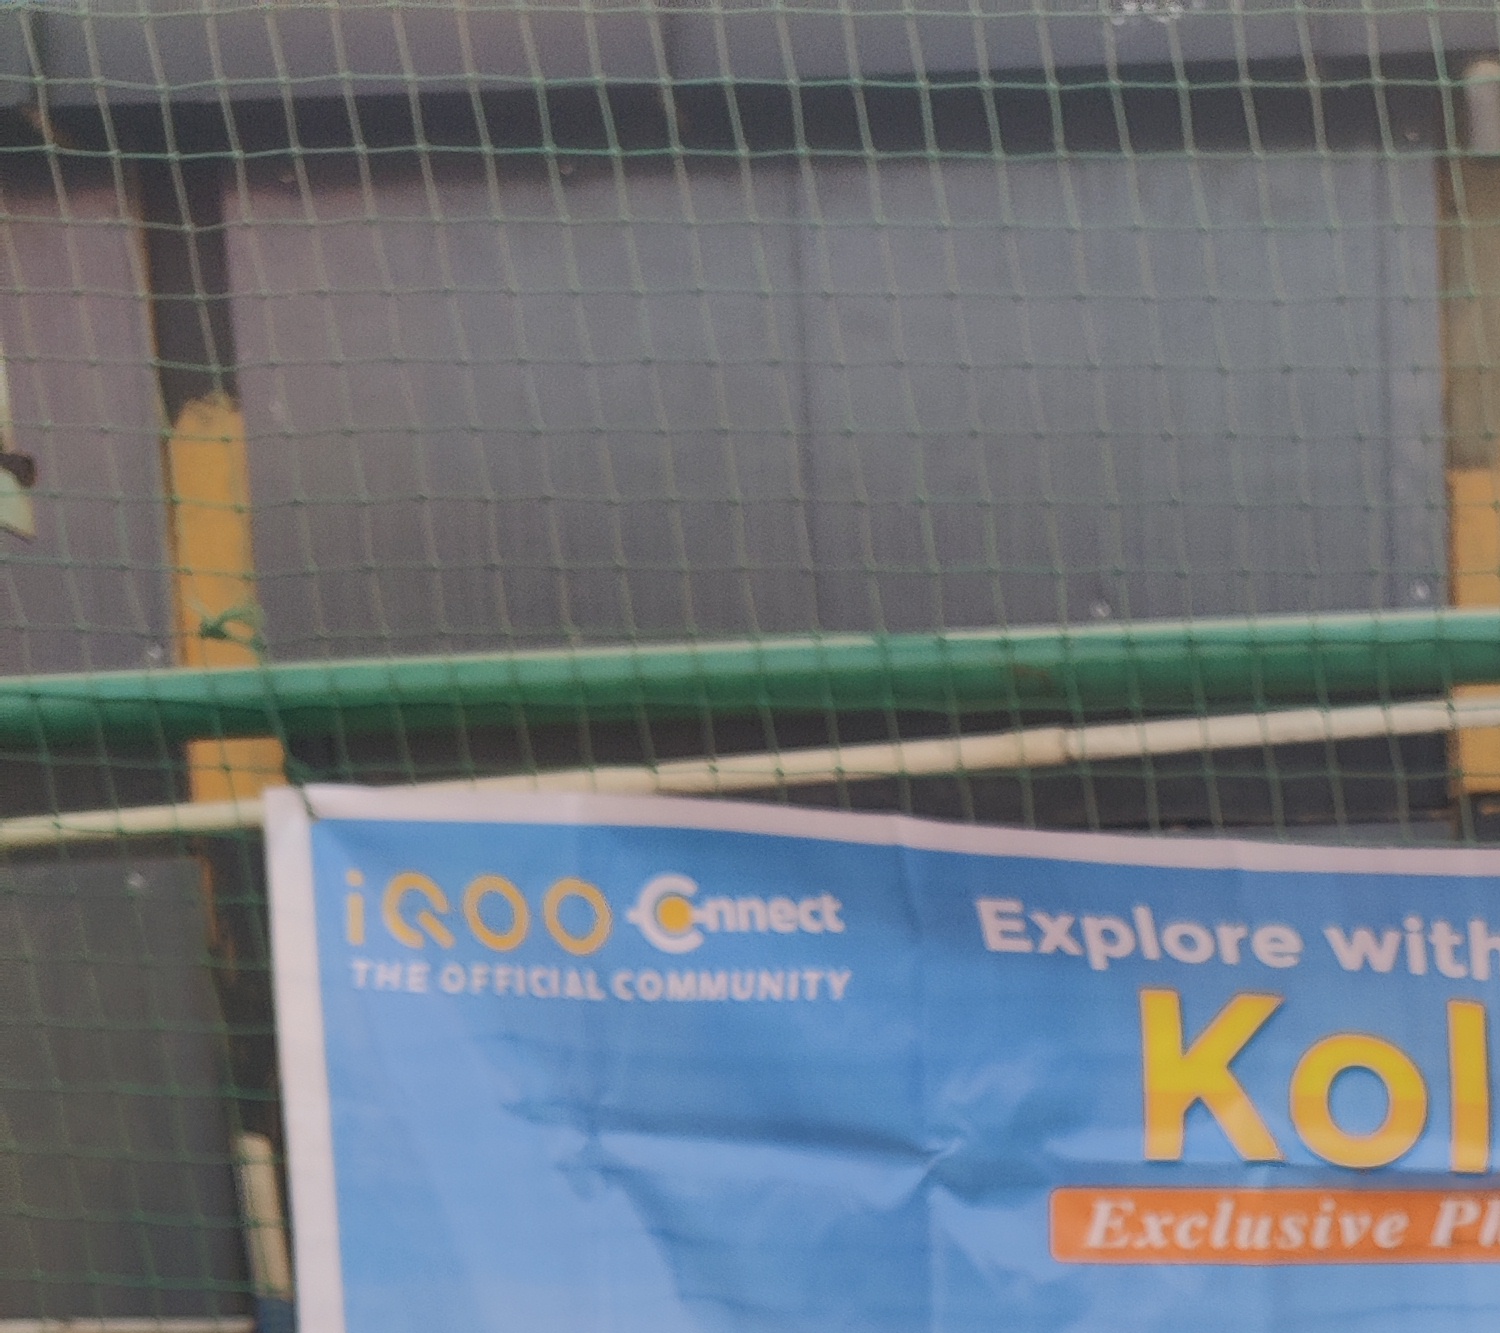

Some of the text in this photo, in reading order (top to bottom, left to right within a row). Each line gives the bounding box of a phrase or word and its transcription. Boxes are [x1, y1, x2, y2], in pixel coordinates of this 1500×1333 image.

[346, 869, 613, 957] iQOO
[977, 899, 1304, 971] Explore
[352, 959, 852, 1001] THE OFFICIAL COMMUNITY
[1084, 1196, 1410, 1252] Exclusive
